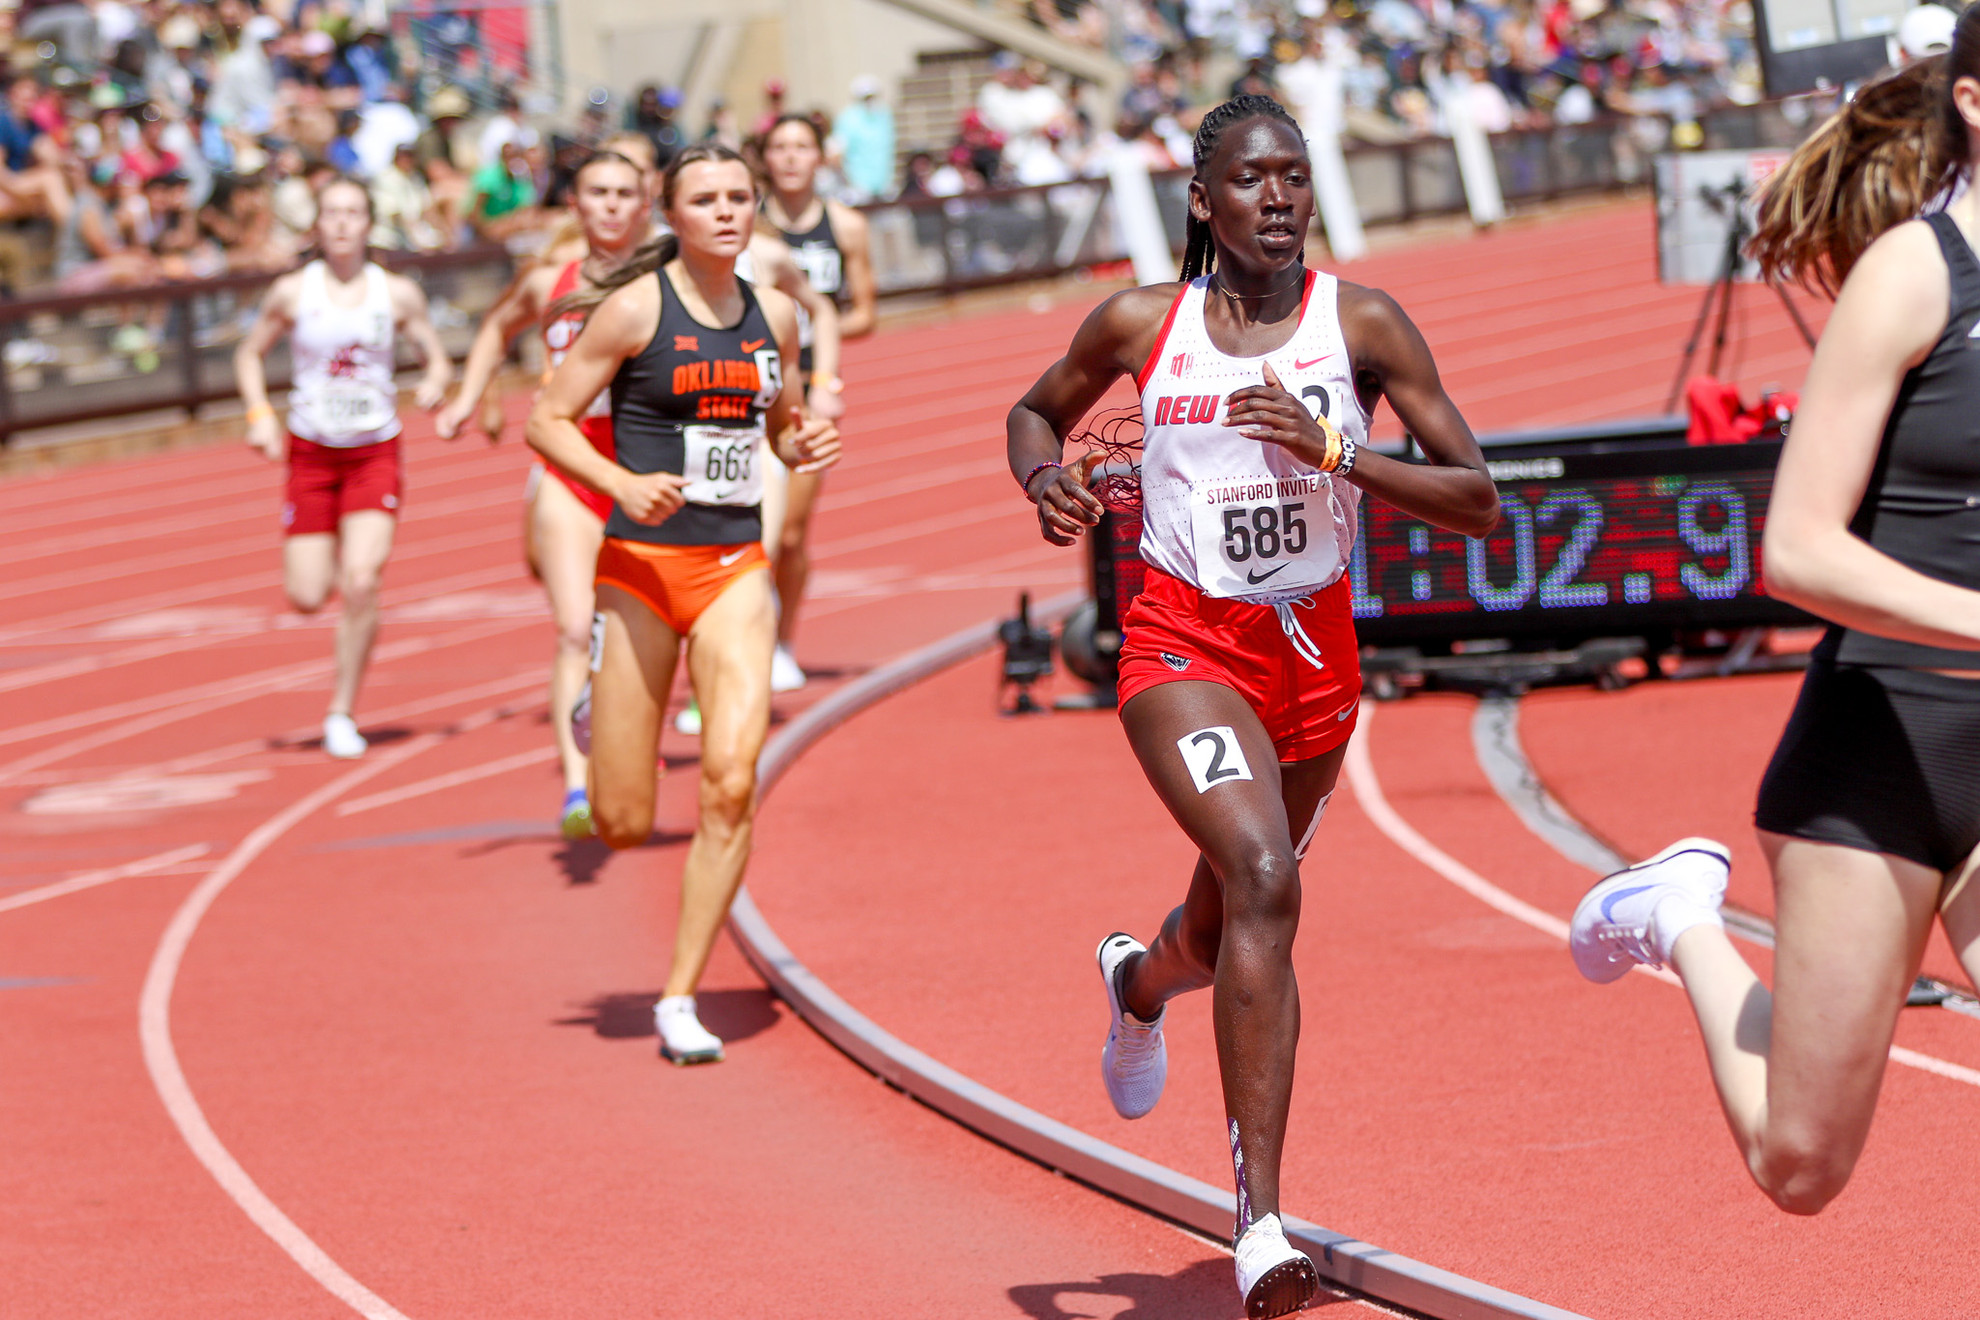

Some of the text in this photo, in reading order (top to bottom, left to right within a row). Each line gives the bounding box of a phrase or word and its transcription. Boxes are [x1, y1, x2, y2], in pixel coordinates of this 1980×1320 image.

[1154, 394, 1221, 426] NEW
[1207, 477, 1318, 505] STANFORD INVITE
[1223, 502, 1308, 563] 585
[1191, 731, 1241, 784] 2
